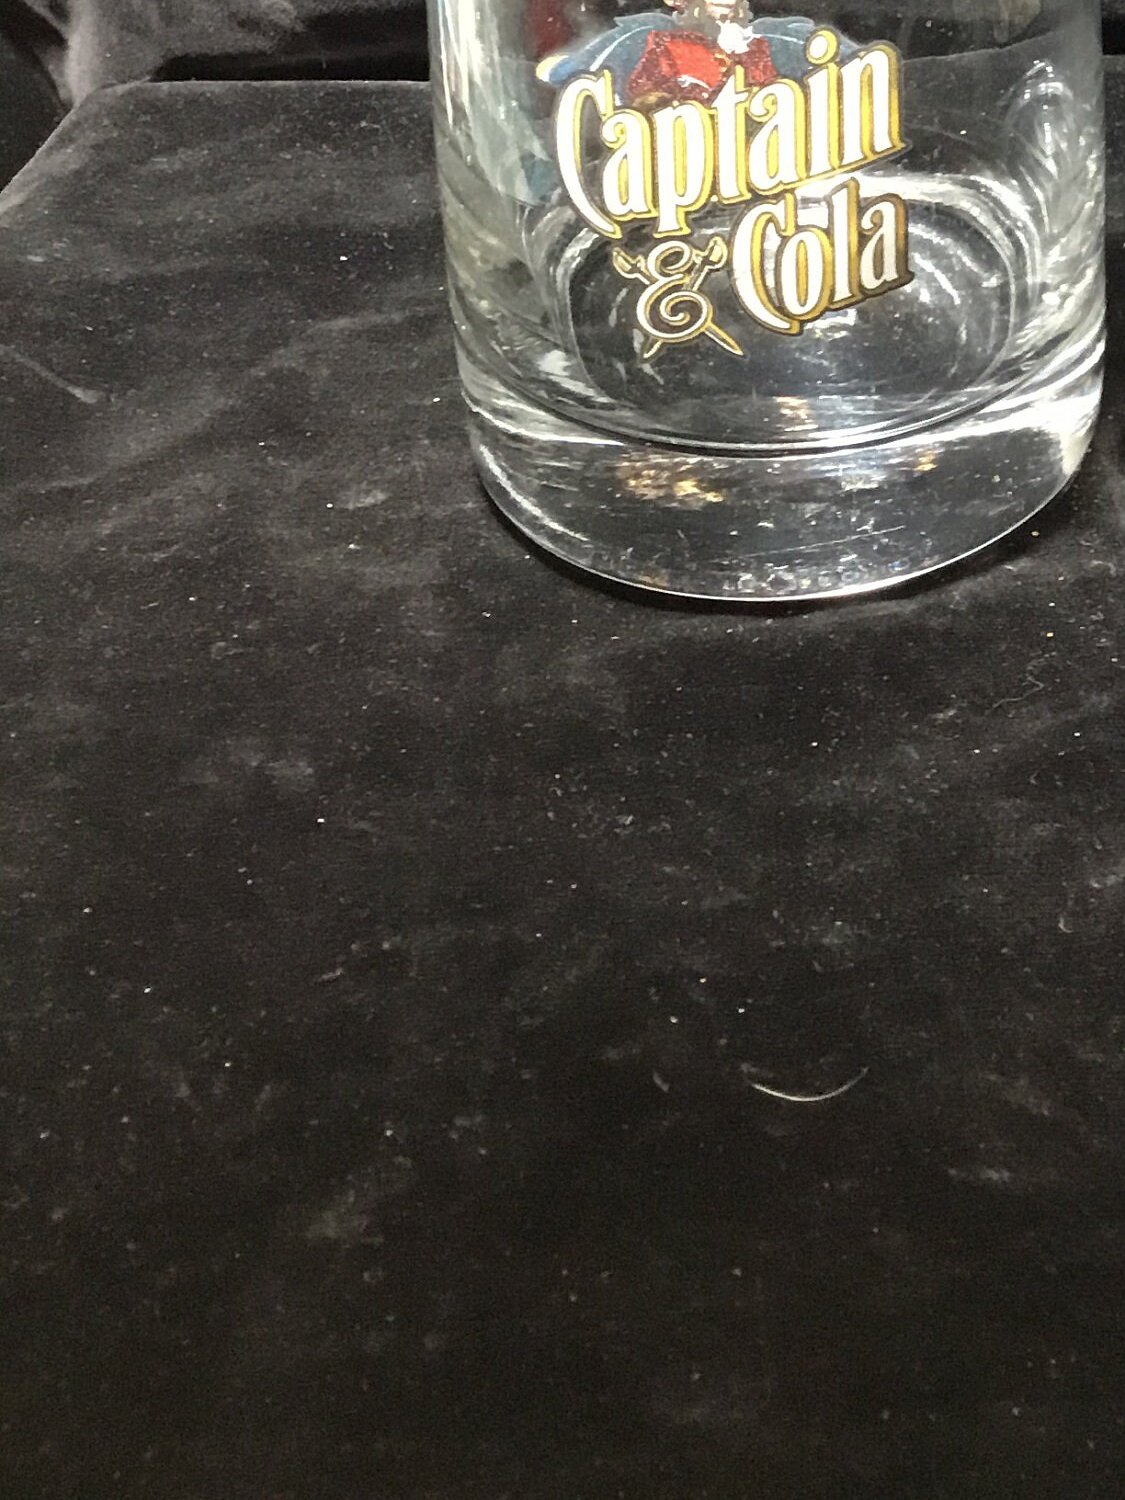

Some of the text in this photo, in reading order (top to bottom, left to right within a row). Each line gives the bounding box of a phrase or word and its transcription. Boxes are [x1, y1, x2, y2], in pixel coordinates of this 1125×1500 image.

[555, 30, 906, 239] Captain
[634, 177, 914, 344] & Cola
